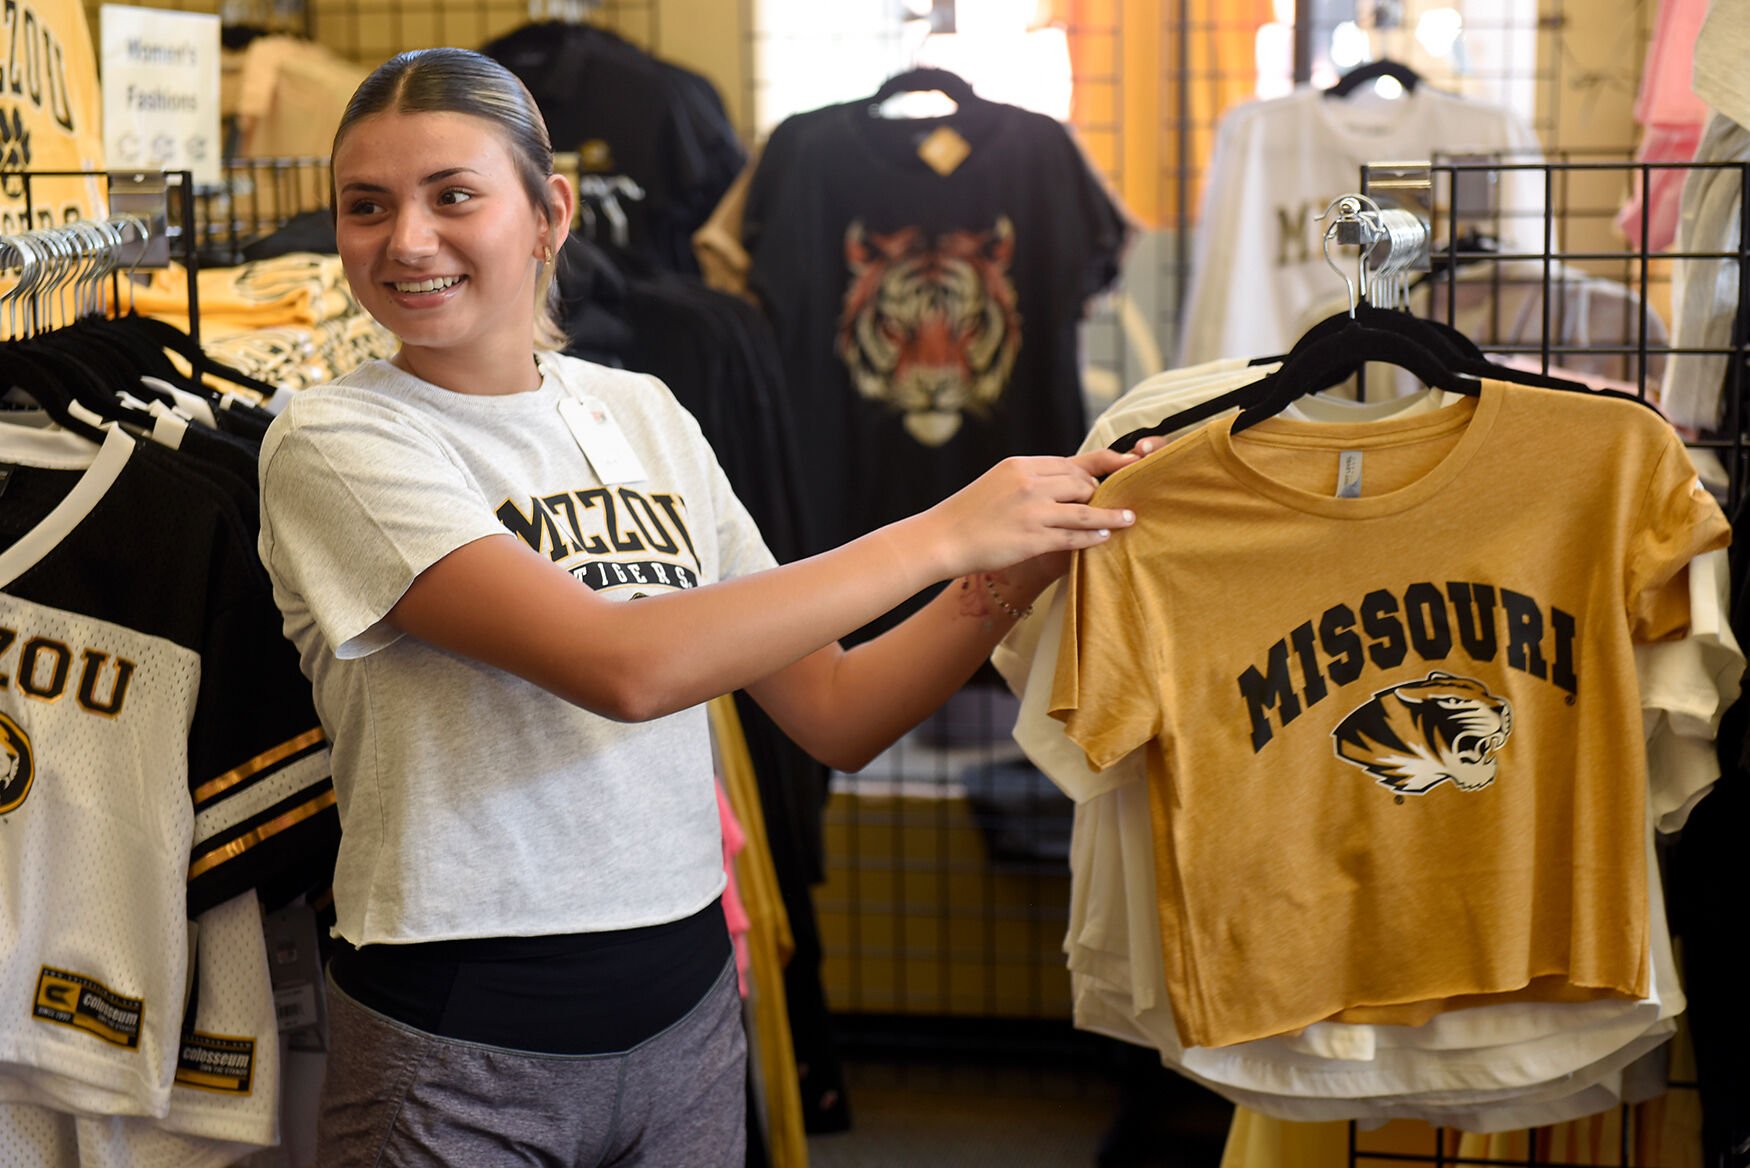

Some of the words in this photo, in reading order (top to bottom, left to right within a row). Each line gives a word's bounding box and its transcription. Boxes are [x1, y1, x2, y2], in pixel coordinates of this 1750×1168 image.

[0, 0, 74, 132] ZOU
[127, 85, 198, 111] Fashions
[573, 562, 689, 590] TIGERS
[1238, 581, 1577, 754] MISSOURI
